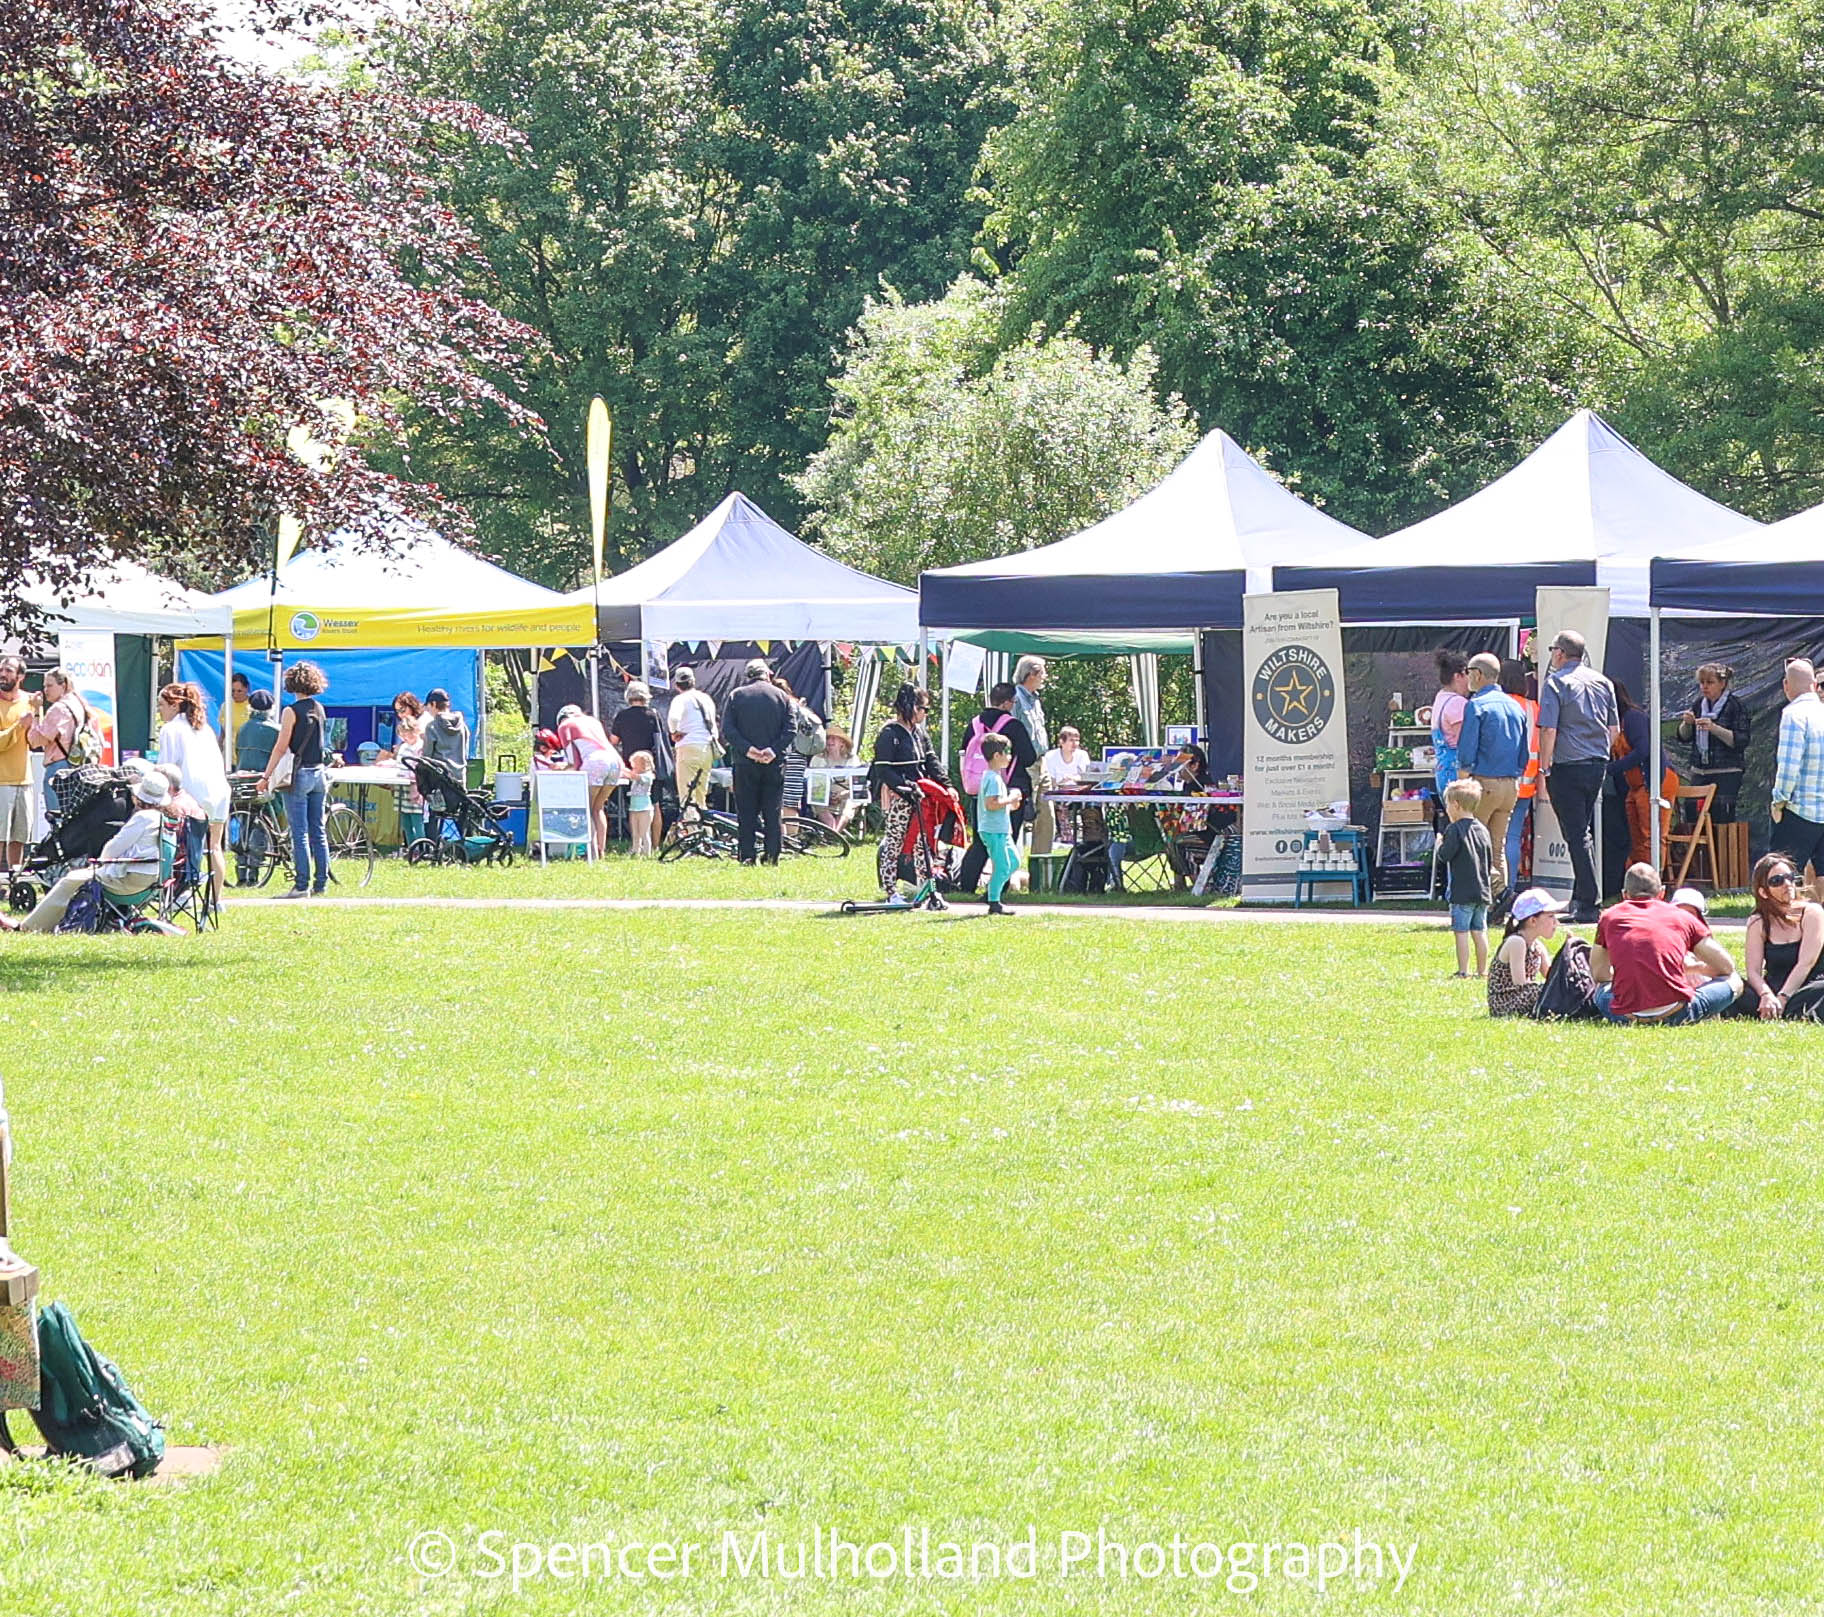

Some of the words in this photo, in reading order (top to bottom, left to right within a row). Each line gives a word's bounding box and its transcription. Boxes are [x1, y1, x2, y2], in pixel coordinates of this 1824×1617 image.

[1264, 613, 1277, 621] Are
[1278, 613, 1293, 622] you
[1301, 610, 1319, 619] local
[322, 618, 359, 628] Wessex
[481, 624, 494, 633] for
[529, 623, 547, 632] and
[549, 623, 580, 633] people
[1250, 625, 1276, 633] Artisan
[1277, 624, 1296, 632] from
[1297, 620, 1334, 631] Wiltshire?
[65, 660, 112, 677] ecodan
[1259, 648, 1327, 681] WILTSHIRE
[1265, 716, 1324, 742] MAKERS
[1256, 755, 1265, 763] 12
[1293, 753, 1334, 761] membership
[1266, 765, 1279, 773] just
